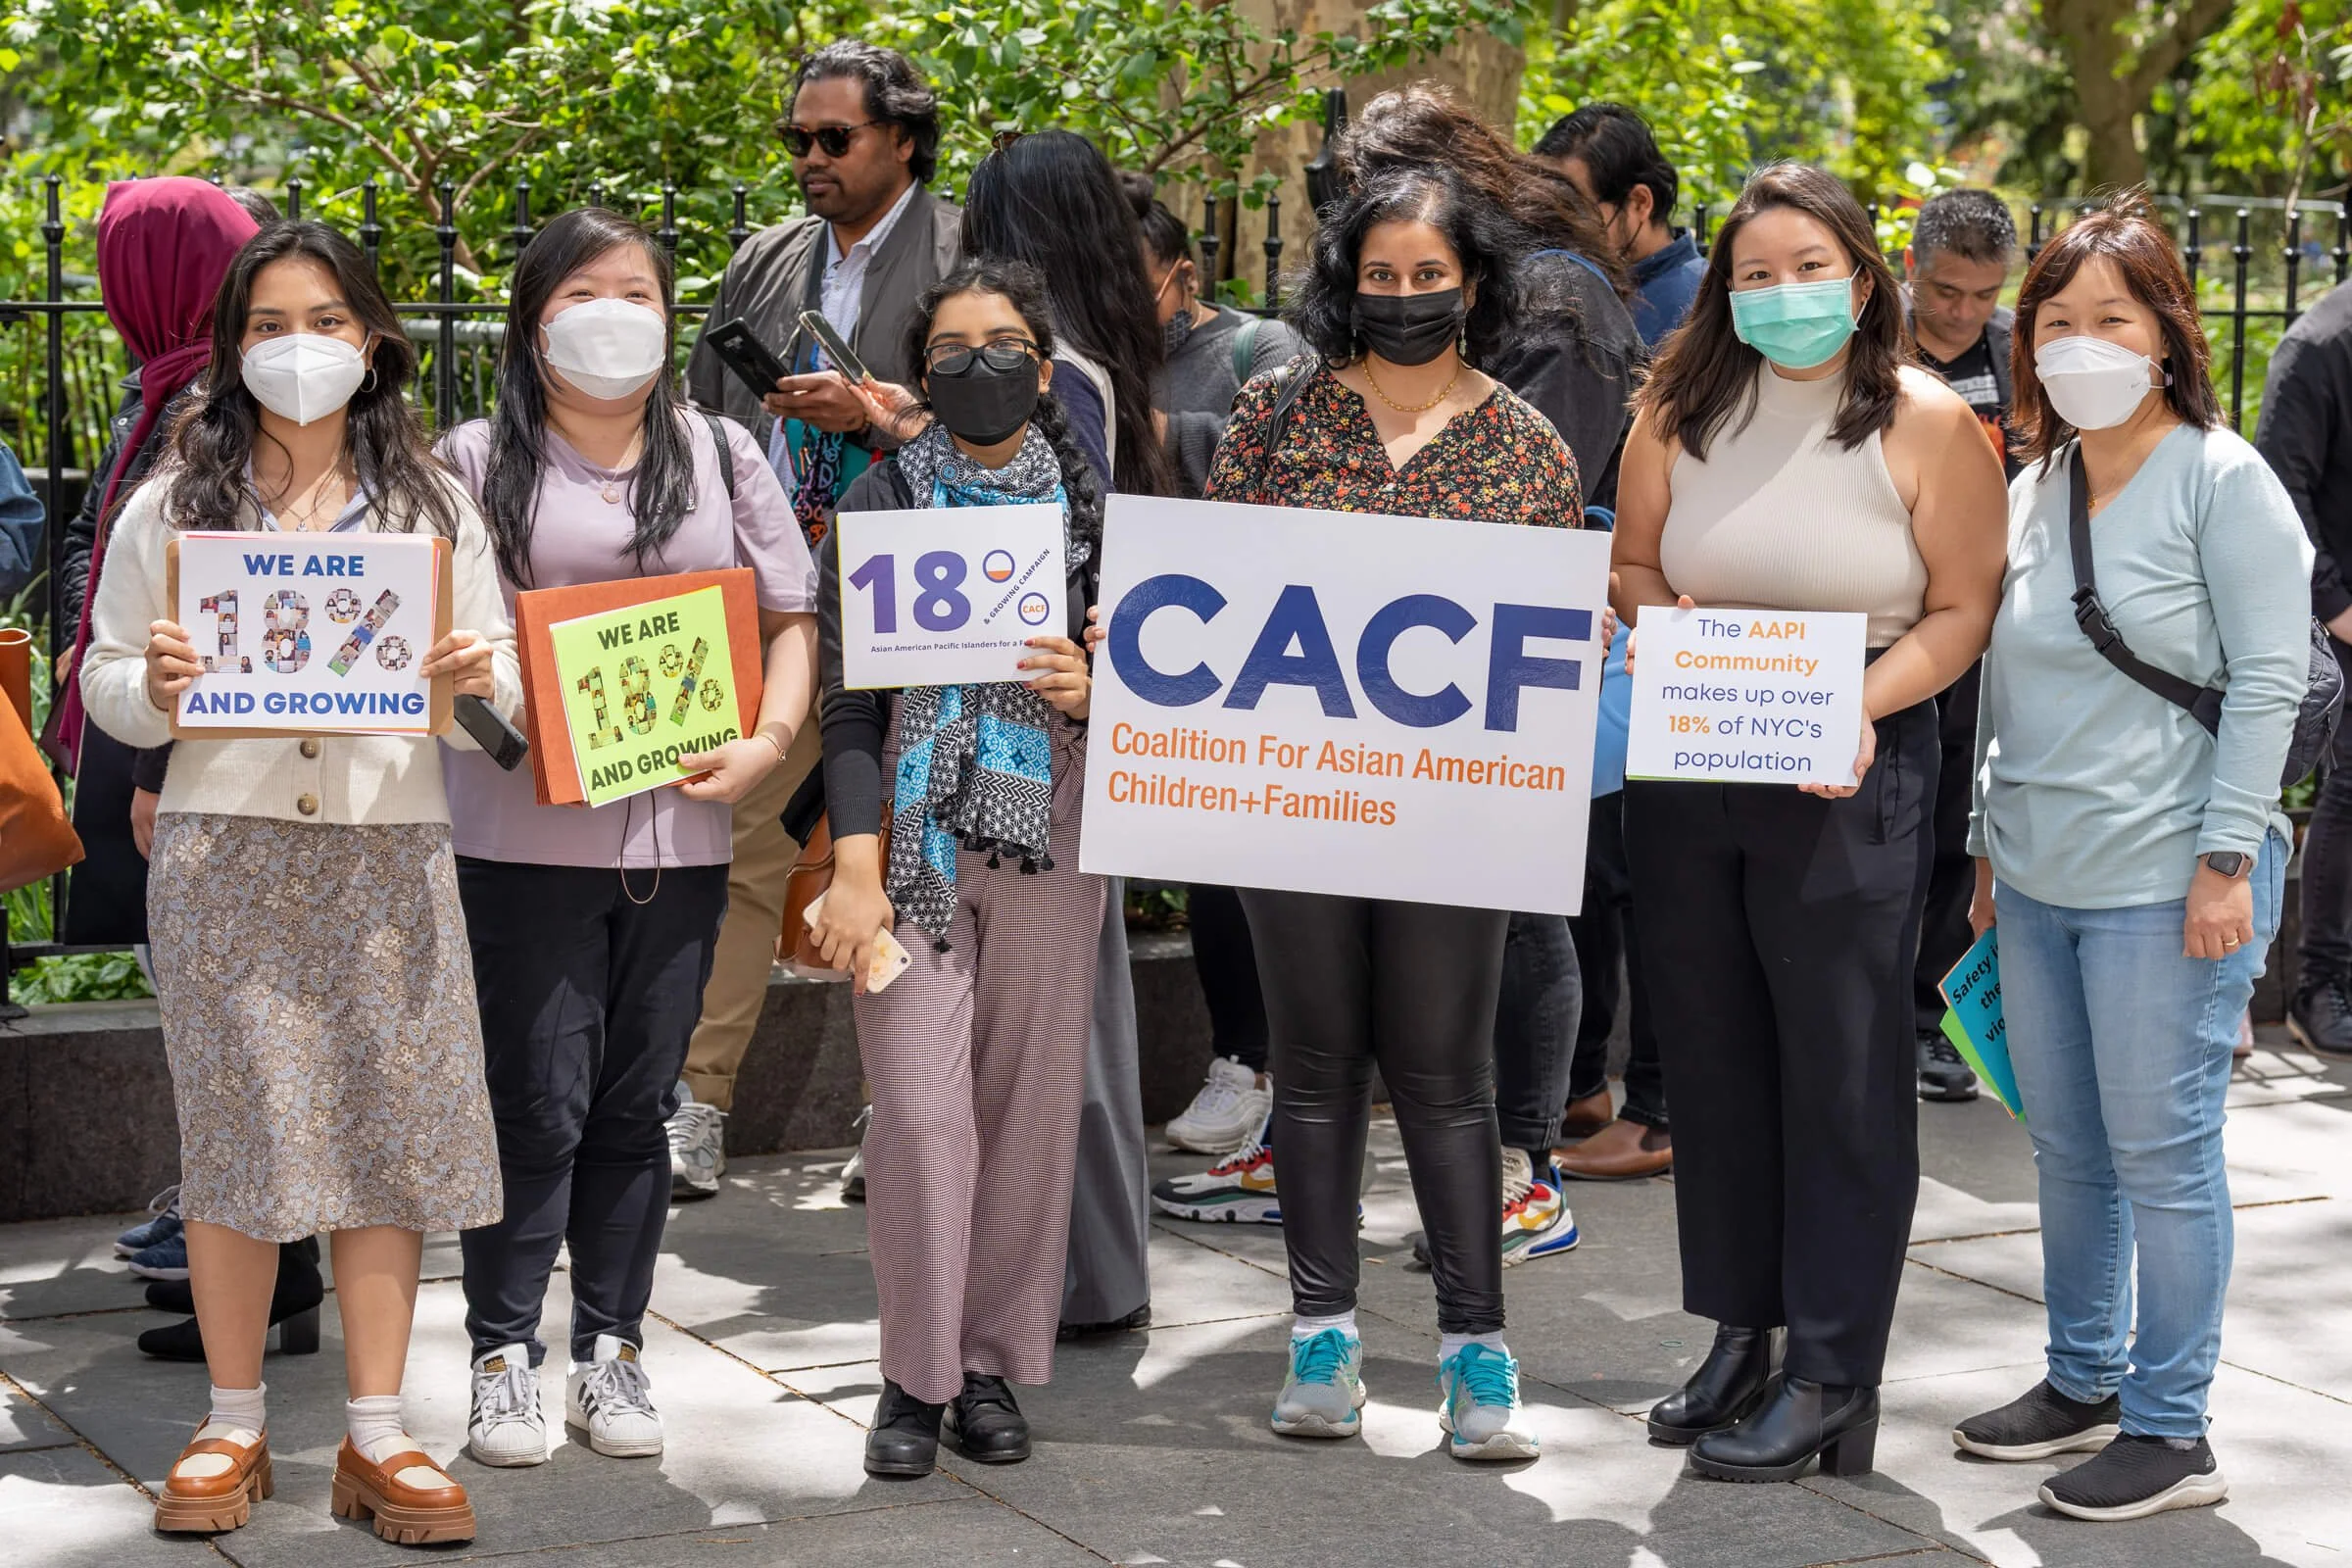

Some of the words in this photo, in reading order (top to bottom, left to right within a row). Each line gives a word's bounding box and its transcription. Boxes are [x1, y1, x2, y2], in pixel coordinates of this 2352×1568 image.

[243, 554, 294, 576] WE
[302, 555, 365, 576] ARE
[989, 583, 1020, 618] GROWING
[1018, 548, 1051, 586] CAMPAIGN
[1022, 605, 1047, 614] CACF
[200, 587, 414, 677] 18%
[597, 623, 634, 650] WE
[638, 612, 681, 641] ARE
[894, 643, 932, 652] American
[933, 641, 959, 650] Pacific
[961, 640, 998, 649] Islanders
[999, 639, 1012, 648] for
[1698, 619, 1741, 638] The
[1748, 620, 1805, 640] AAPI
[1107, 573, 1592, 732] CACF
[1675, 651, 1819, 677] Community
[186, 692, 256, 714] AND
[264, 692, 424, 714] GROWING
[576, 636, 724, 751] 18%
[1662, 683, 1738, 702] makes
[1745, 689, 1775, 707] up
[1782, 690, 1834, 706] over
[1669, 715, 1710, 734] 18%
[1718, 716, 1744, 735] of
[1751, 717, 1822, 739] NYC's
[591, 760, 633, 791] AND
[637, 727, 738, 775] GROWING
[1111, 722, 1247, 764] Coalition
[1258, 735, 1310, 770] For
[1316, 740, 1404, 777] Asian
[1411, 748, 1566, 791] American
[1674, 751, 1811, 771] population
[1107, 770, 1396, 826] Children+Families
[1952, 955, 1992, 1004] Safety
